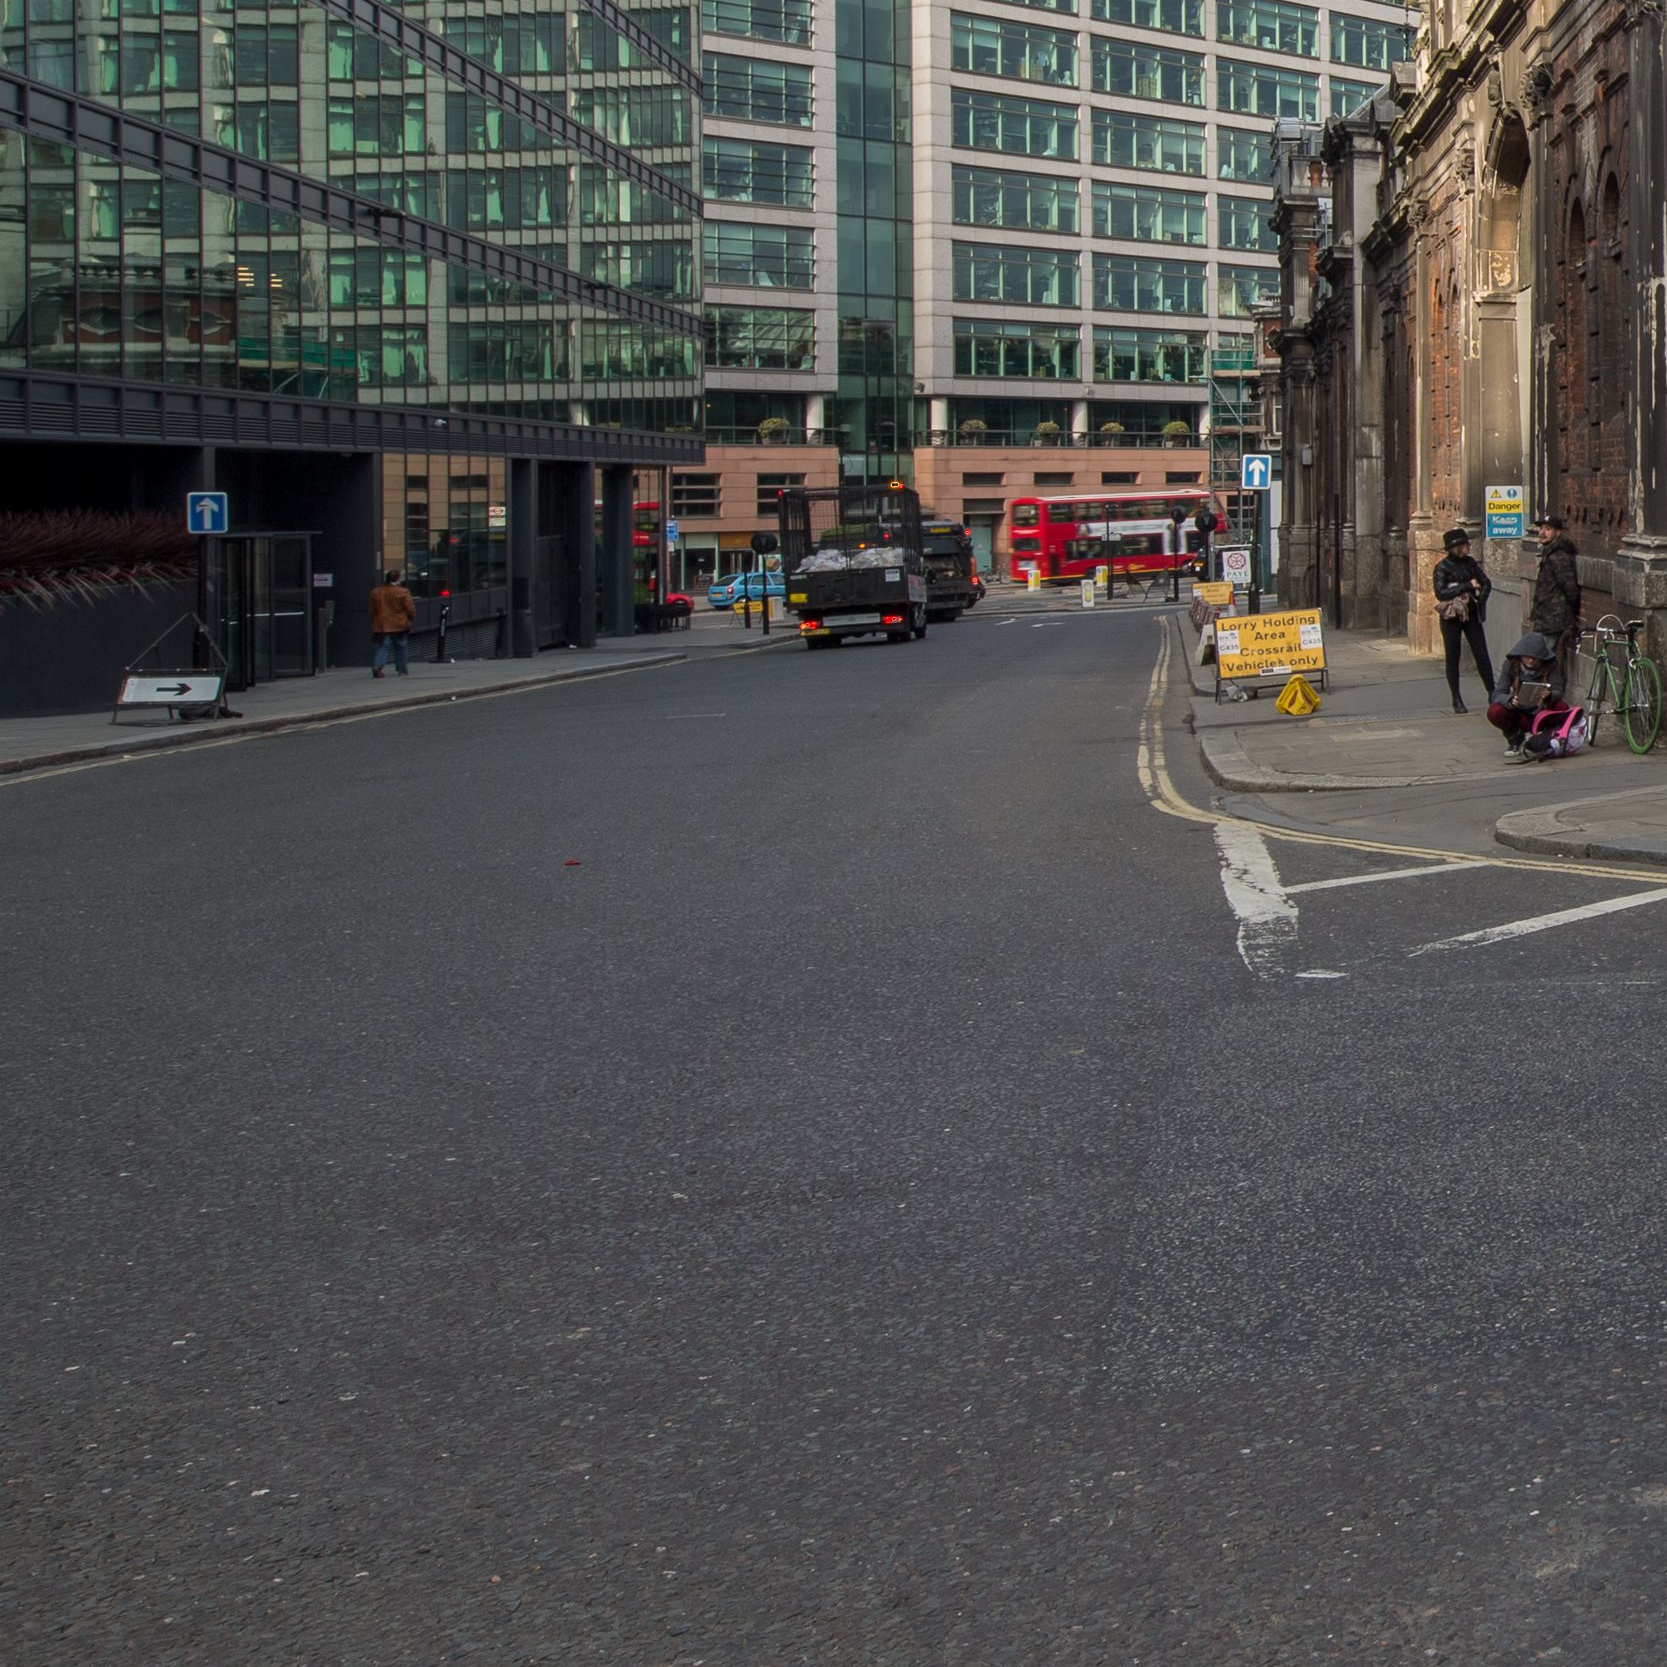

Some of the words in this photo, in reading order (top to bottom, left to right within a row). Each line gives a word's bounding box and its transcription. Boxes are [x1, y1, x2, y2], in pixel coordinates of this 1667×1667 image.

[1488, 502, 1521, 511] Danger
[1492, 515, 1518, 524] Keep
[1492, 527, 1518, 535] away
[1221, 621, 1257, 632] Lorry
[1263, 615, 1316, 628] Holding
[1254, 631, 1286, 641] Area
[1240, 642, 1303, 657] Crossrail
[1226, 659, 1285, 672] Vehicles
[1289, 655, 1319, 667] only
